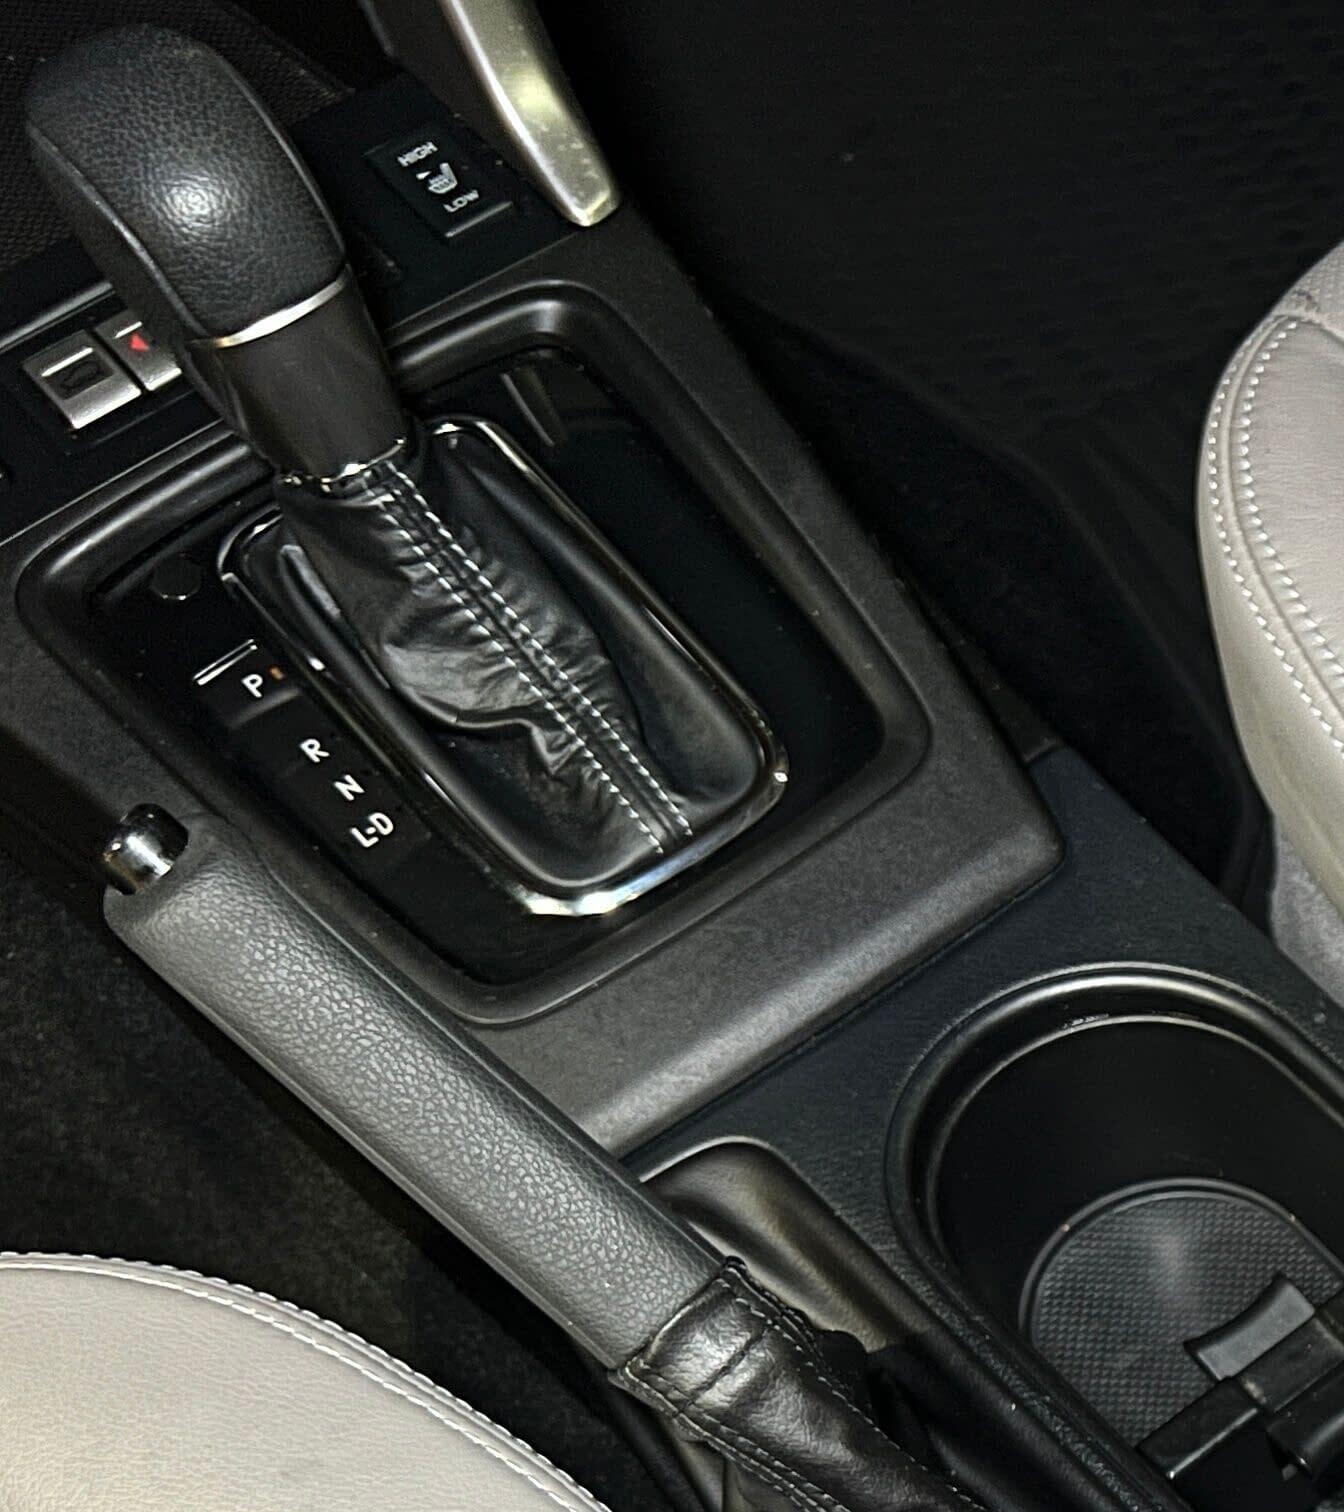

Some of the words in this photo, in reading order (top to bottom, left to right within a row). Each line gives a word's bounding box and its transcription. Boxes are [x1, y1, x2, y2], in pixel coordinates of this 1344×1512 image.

[397, 141, 438, 167] HIGH
[443, 189, 479, 212] LOW
[241, 674, 264, 698] P
[300, 738, 330, 763] R
[333, 774, 365, 801] N
